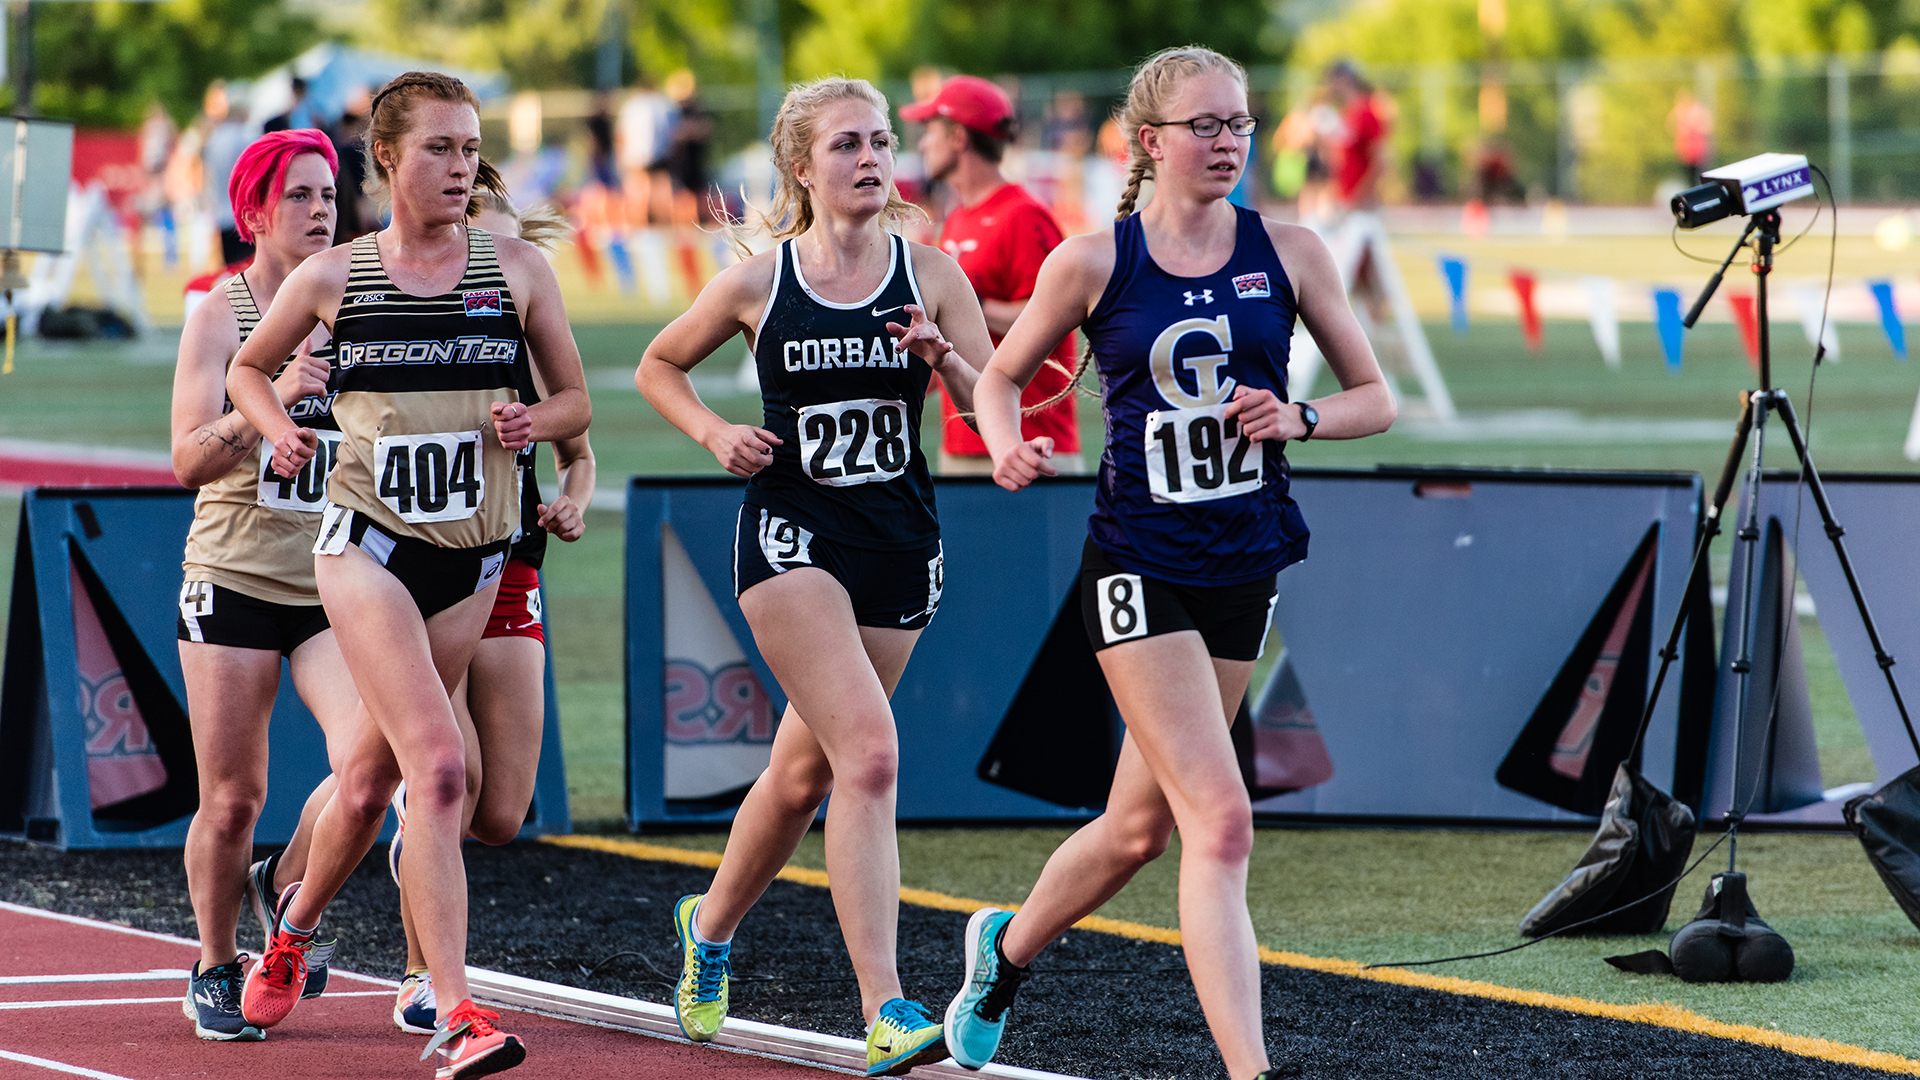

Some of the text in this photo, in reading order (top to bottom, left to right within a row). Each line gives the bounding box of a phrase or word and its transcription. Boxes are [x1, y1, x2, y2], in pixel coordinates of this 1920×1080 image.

[1761, 170, 1803, 195] LYNX
[363, 293, 385, 302] asics
[463, 290, 499, 298] CASCADE
[466, 297, 499, 308] CCC
[1237, 279, 1267, 291] CCC
[783, 336, 909, 372] CORBAN
[1149, 314, 1237, 410] G
[805, 405, 906, 480] 228
[1153, 416, 1259, 493] 192
[380, 441, 480, 513] 404
[320, 503, 349, 550] 7
[774, 520, 800, 560] 9
[185, 580, 207, 613] 4
[1108, 577, 1138, 636] 8
